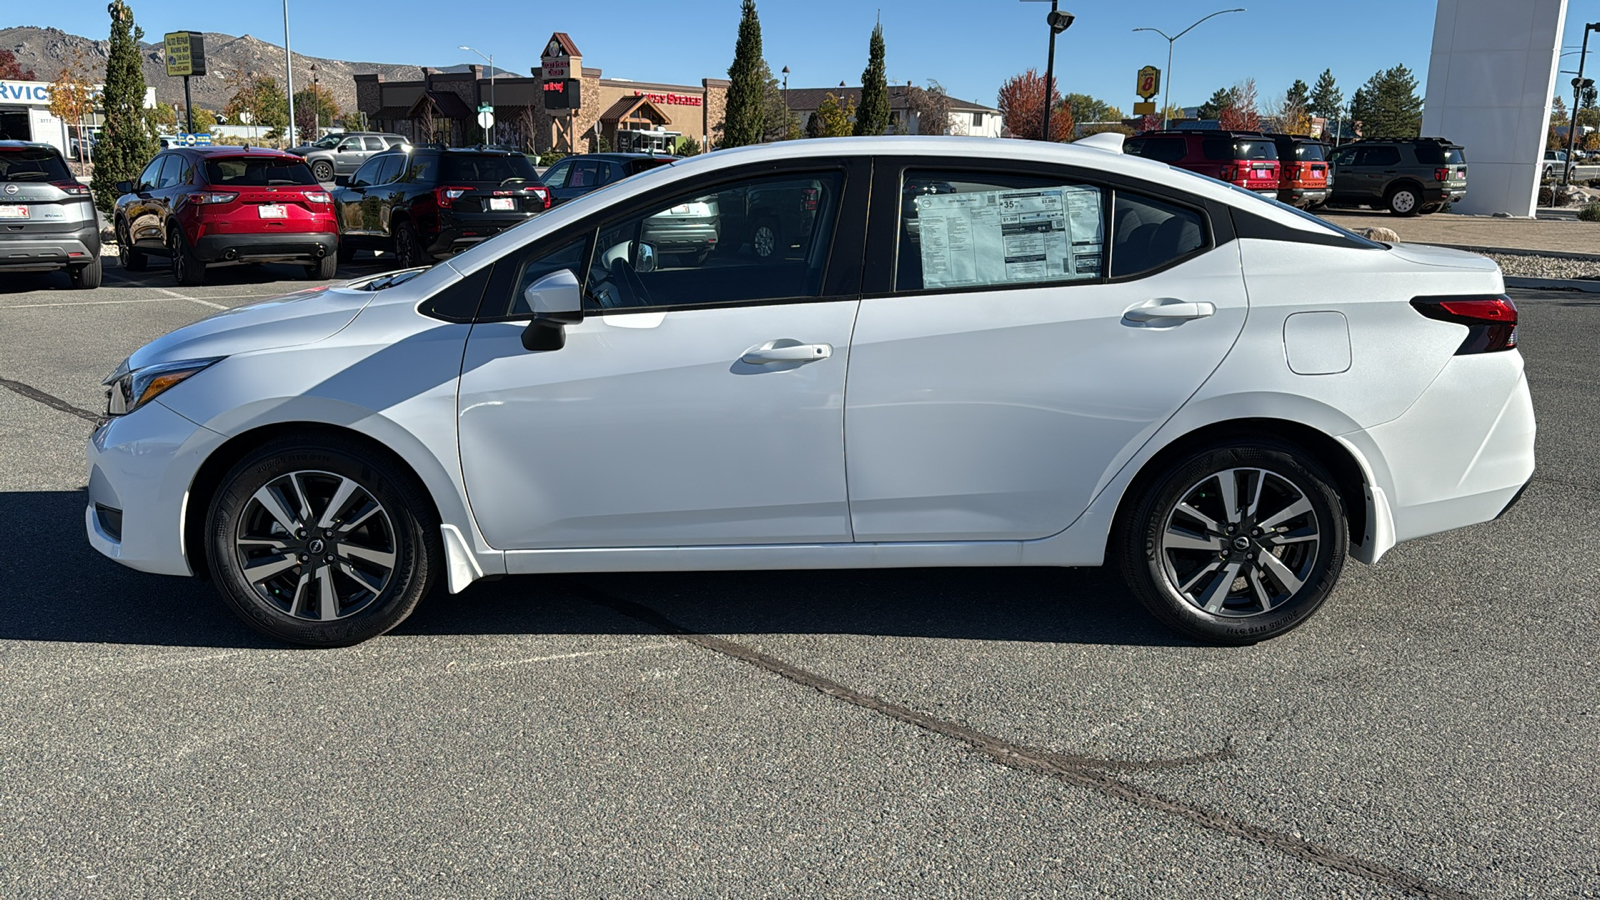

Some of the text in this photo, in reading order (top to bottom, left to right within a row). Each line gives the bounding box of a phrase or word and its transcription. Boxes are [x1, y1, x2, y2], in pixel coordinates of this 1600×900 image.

[1141, 76, 1154, 92] 8
[0, 85, 48, 101] RVIC
[633, 90, 667, 104] CKY
[1003, 200, 1014, 209] 35
[393, 540, 413, 596] KUMHO
